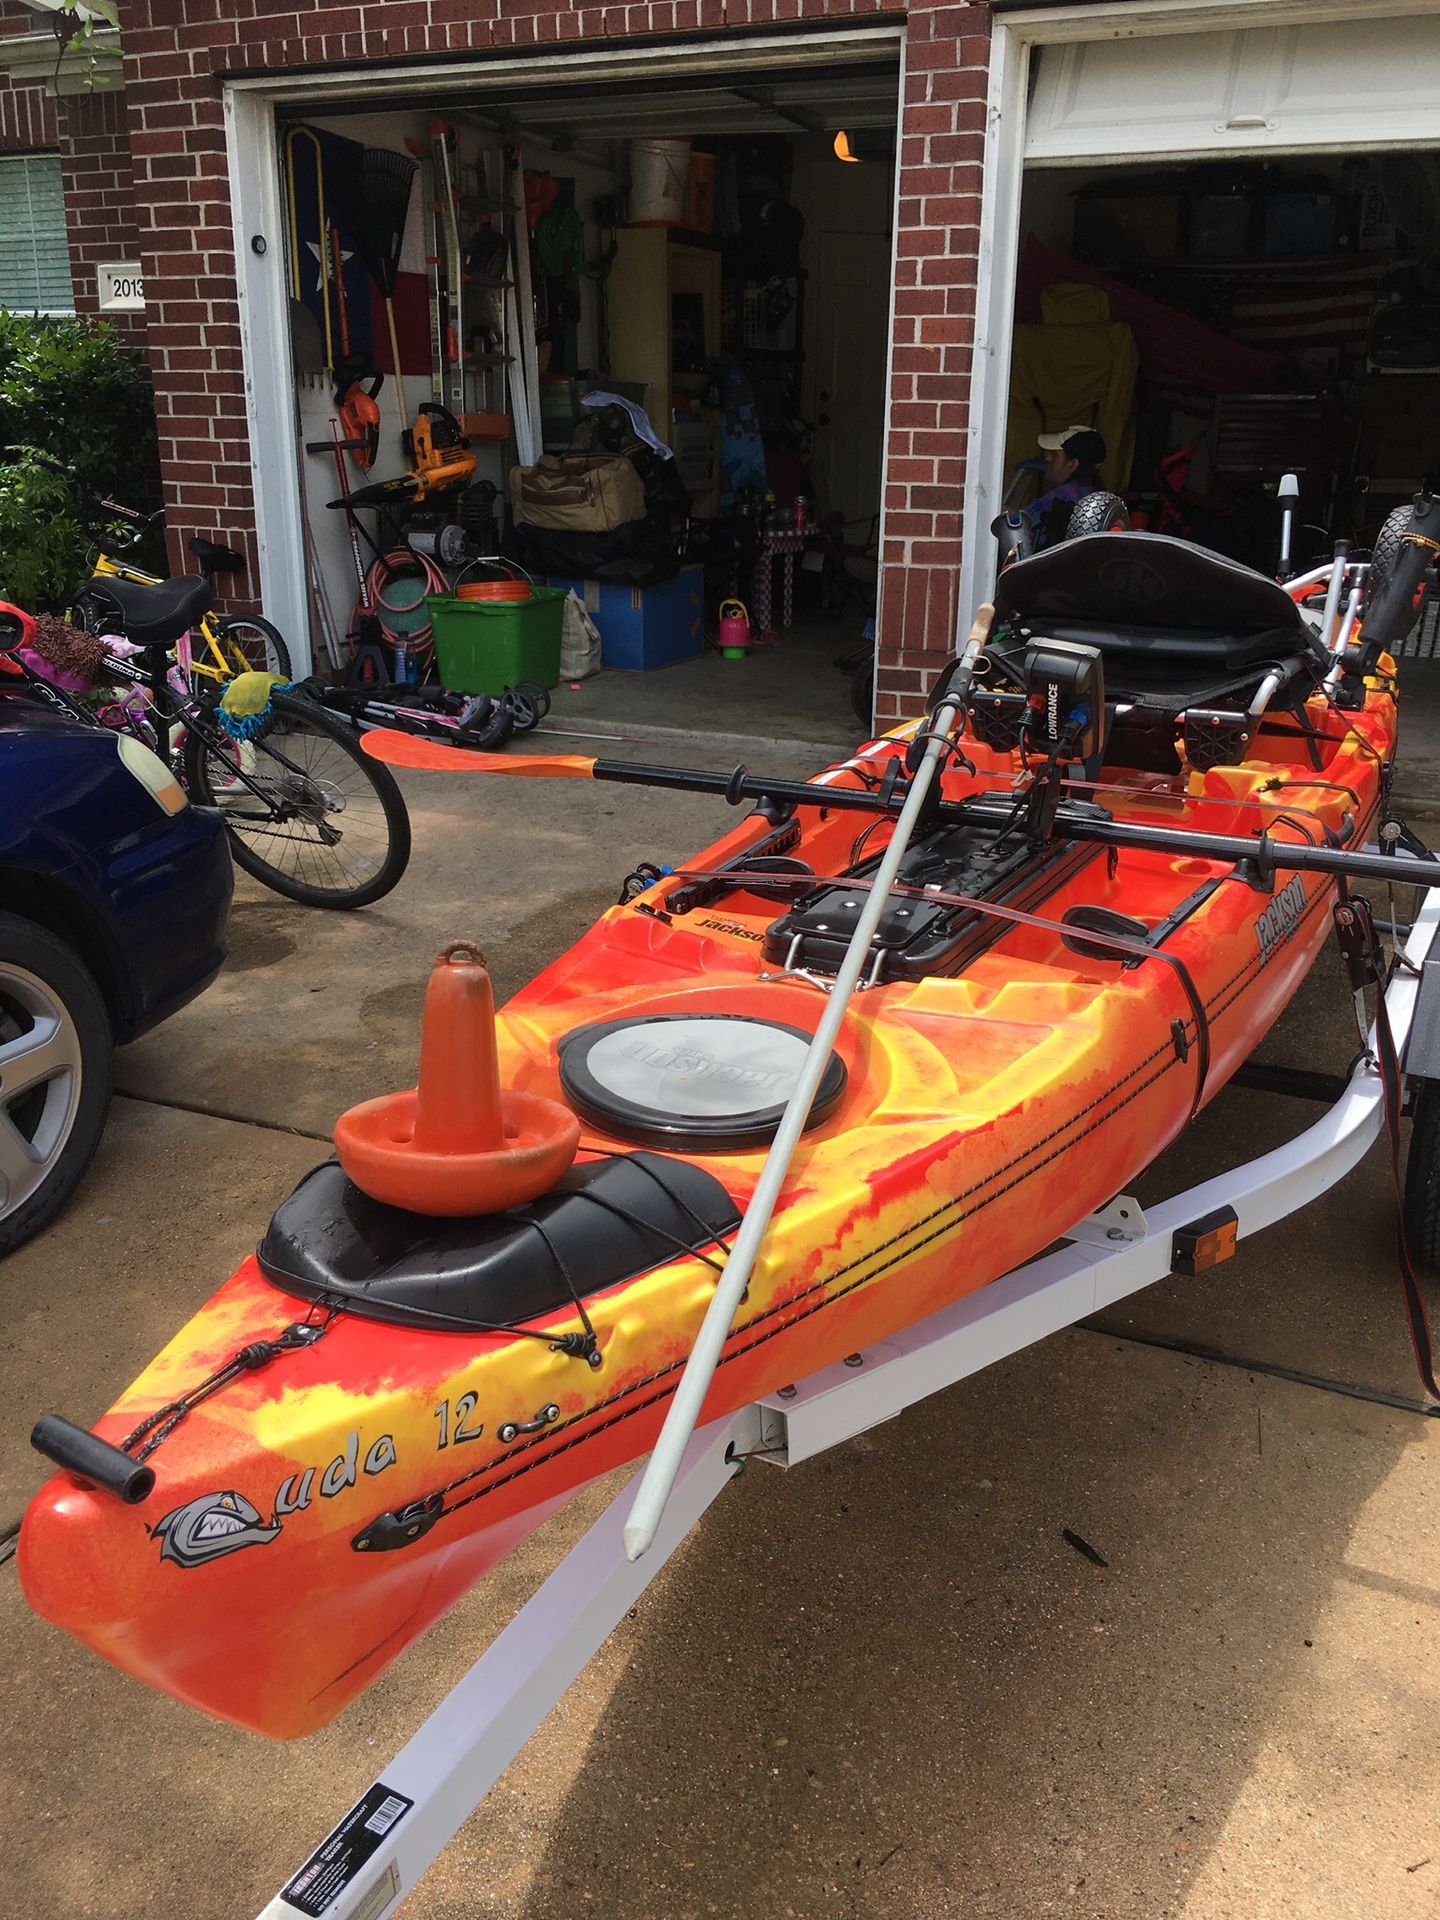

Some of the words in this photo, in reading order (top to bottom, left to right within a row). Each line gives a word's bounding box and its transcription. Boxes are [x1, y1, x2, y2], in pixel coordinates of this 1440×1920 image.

[113, 278, 145, 298] 2013
[1047, 682, 1059, 740] LOWRANCE
[695, 919, 766, 944] Jackso
[434, 1391, 484, 1451] 12
[319, 1832, 344, 1859] PERSONAL
[325, 1842, 344, 1862] TRAILER
